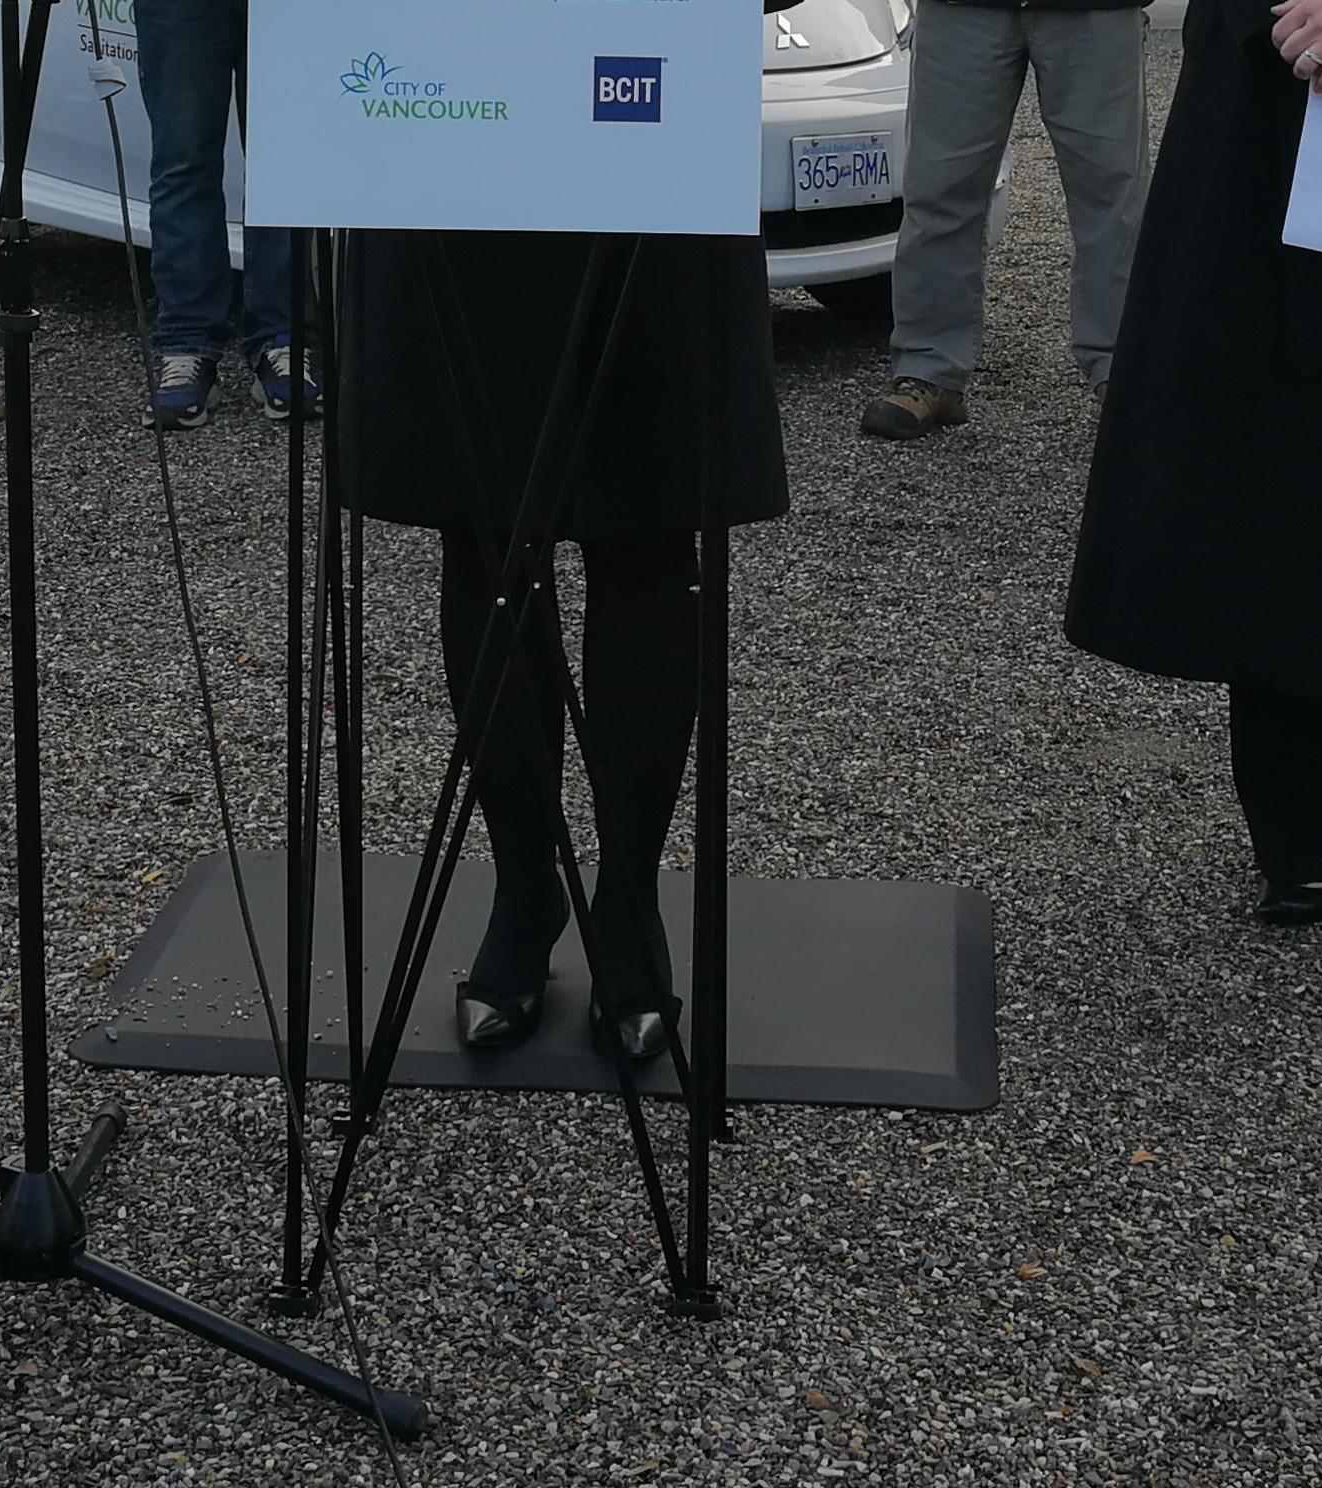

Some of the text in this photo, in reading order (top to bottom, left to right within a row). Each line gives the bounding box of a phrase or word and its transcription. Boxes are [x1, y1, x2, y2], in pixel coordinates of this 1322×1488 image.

[384, 81, 446, 97] CITY OF
[598, 76, 656, 104] BCIT
[362, 98, 508, 120] VANCOUVER
